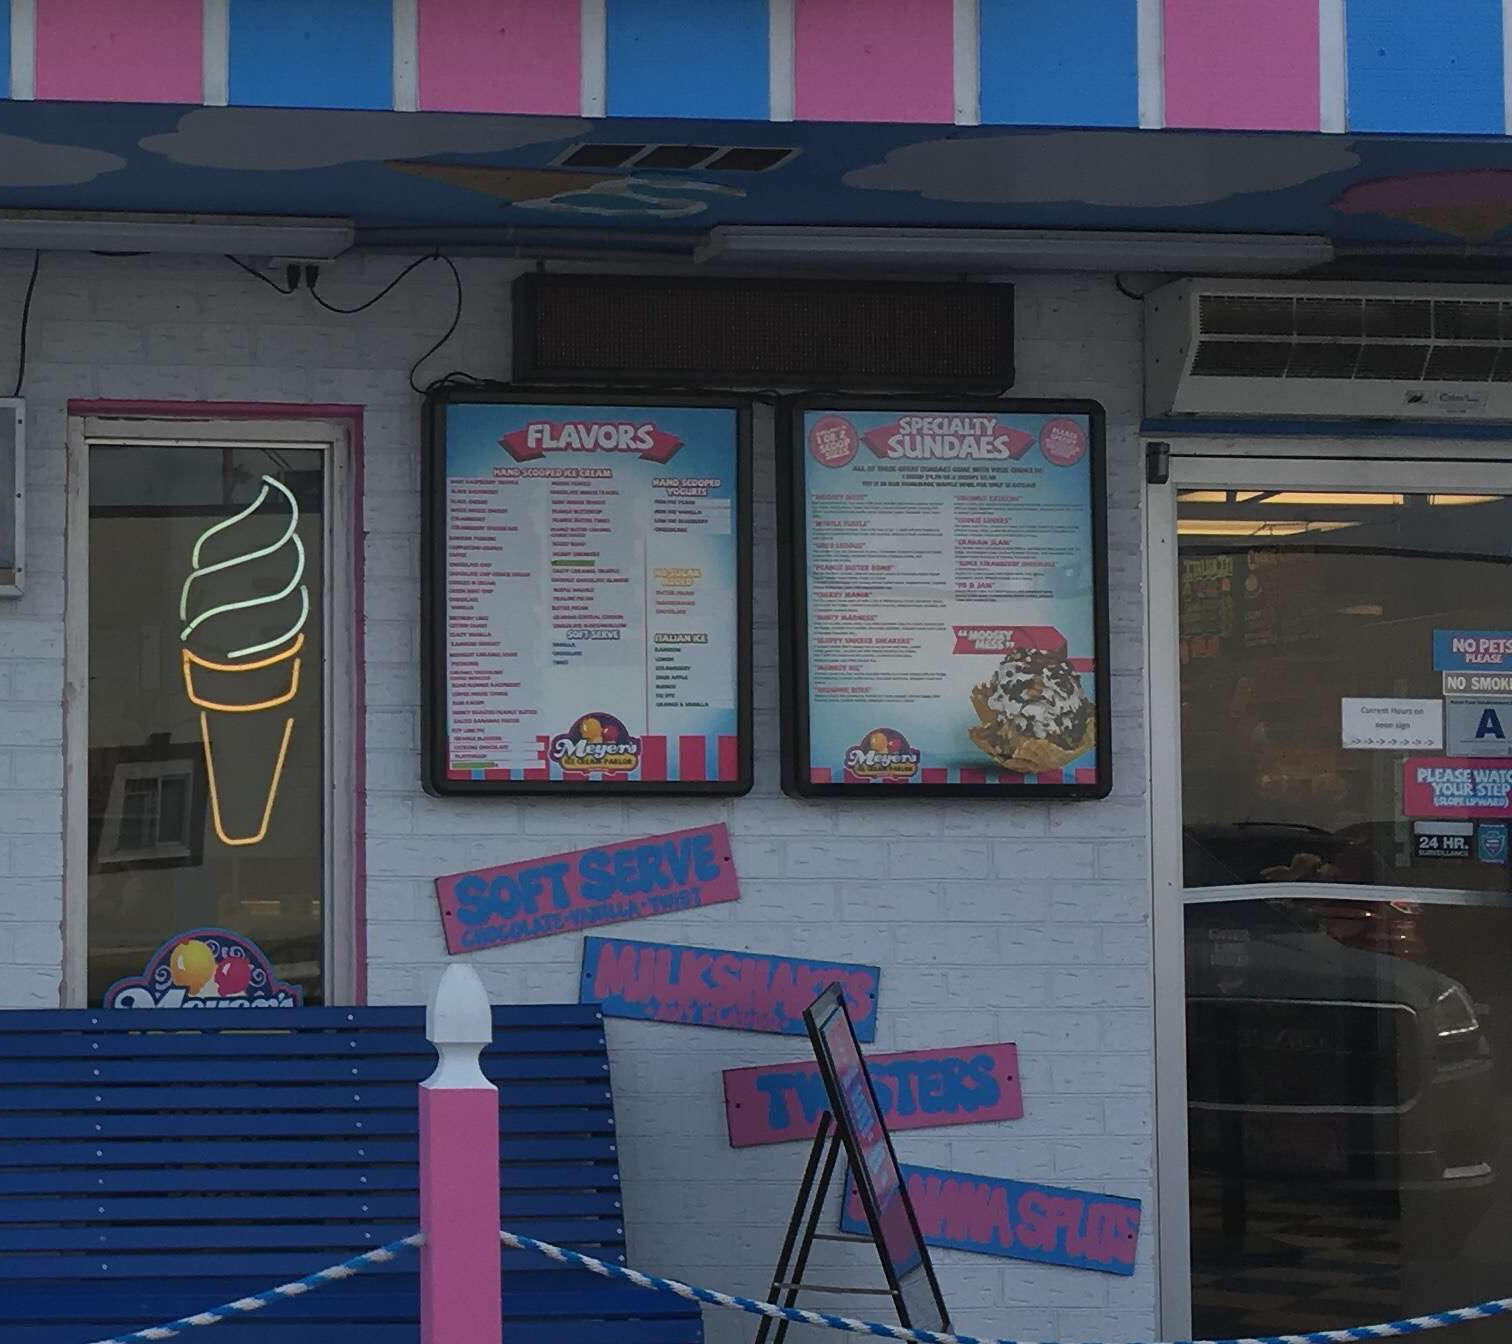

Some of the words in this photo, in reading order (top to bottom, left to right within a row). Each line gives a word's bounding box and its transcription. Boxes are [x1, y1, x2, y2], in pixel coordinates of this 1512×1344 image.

[898, 416, 997, 435] SPECIALTY
[526, 422, 655, 450] FLAVORS
[887, 434, 1010, 459] SUNDAES
[1452, 638, 1476, 653] NO
[1479, 639, 1512, 654] PETS
[1465, 653, 1503, 664] PLEASE
[1447, 676, 1466, 690] NO
[1360, 706, 1389, 715] Current
[1391, 707, 1413, 715] Hours
[1395, 721, 1411, 730] sign
[1475, 708, 1506, 739] A
[1417, 768, 1472, 783] PLEASE
[1432, 782, 1474, 796] YOUR
[1475, 784, 1511, 797] STEP
[1419, 836, 1438, 849] 24
[1442, 836, 1469, 849] HR.
[454, 860, 571, 927] SOFT
[578, 832, 721, 902] SERVE
[756, 1052, 1001, 1130] TWSTERS
[1015, 1190, 1140, 1264] SPLITS
